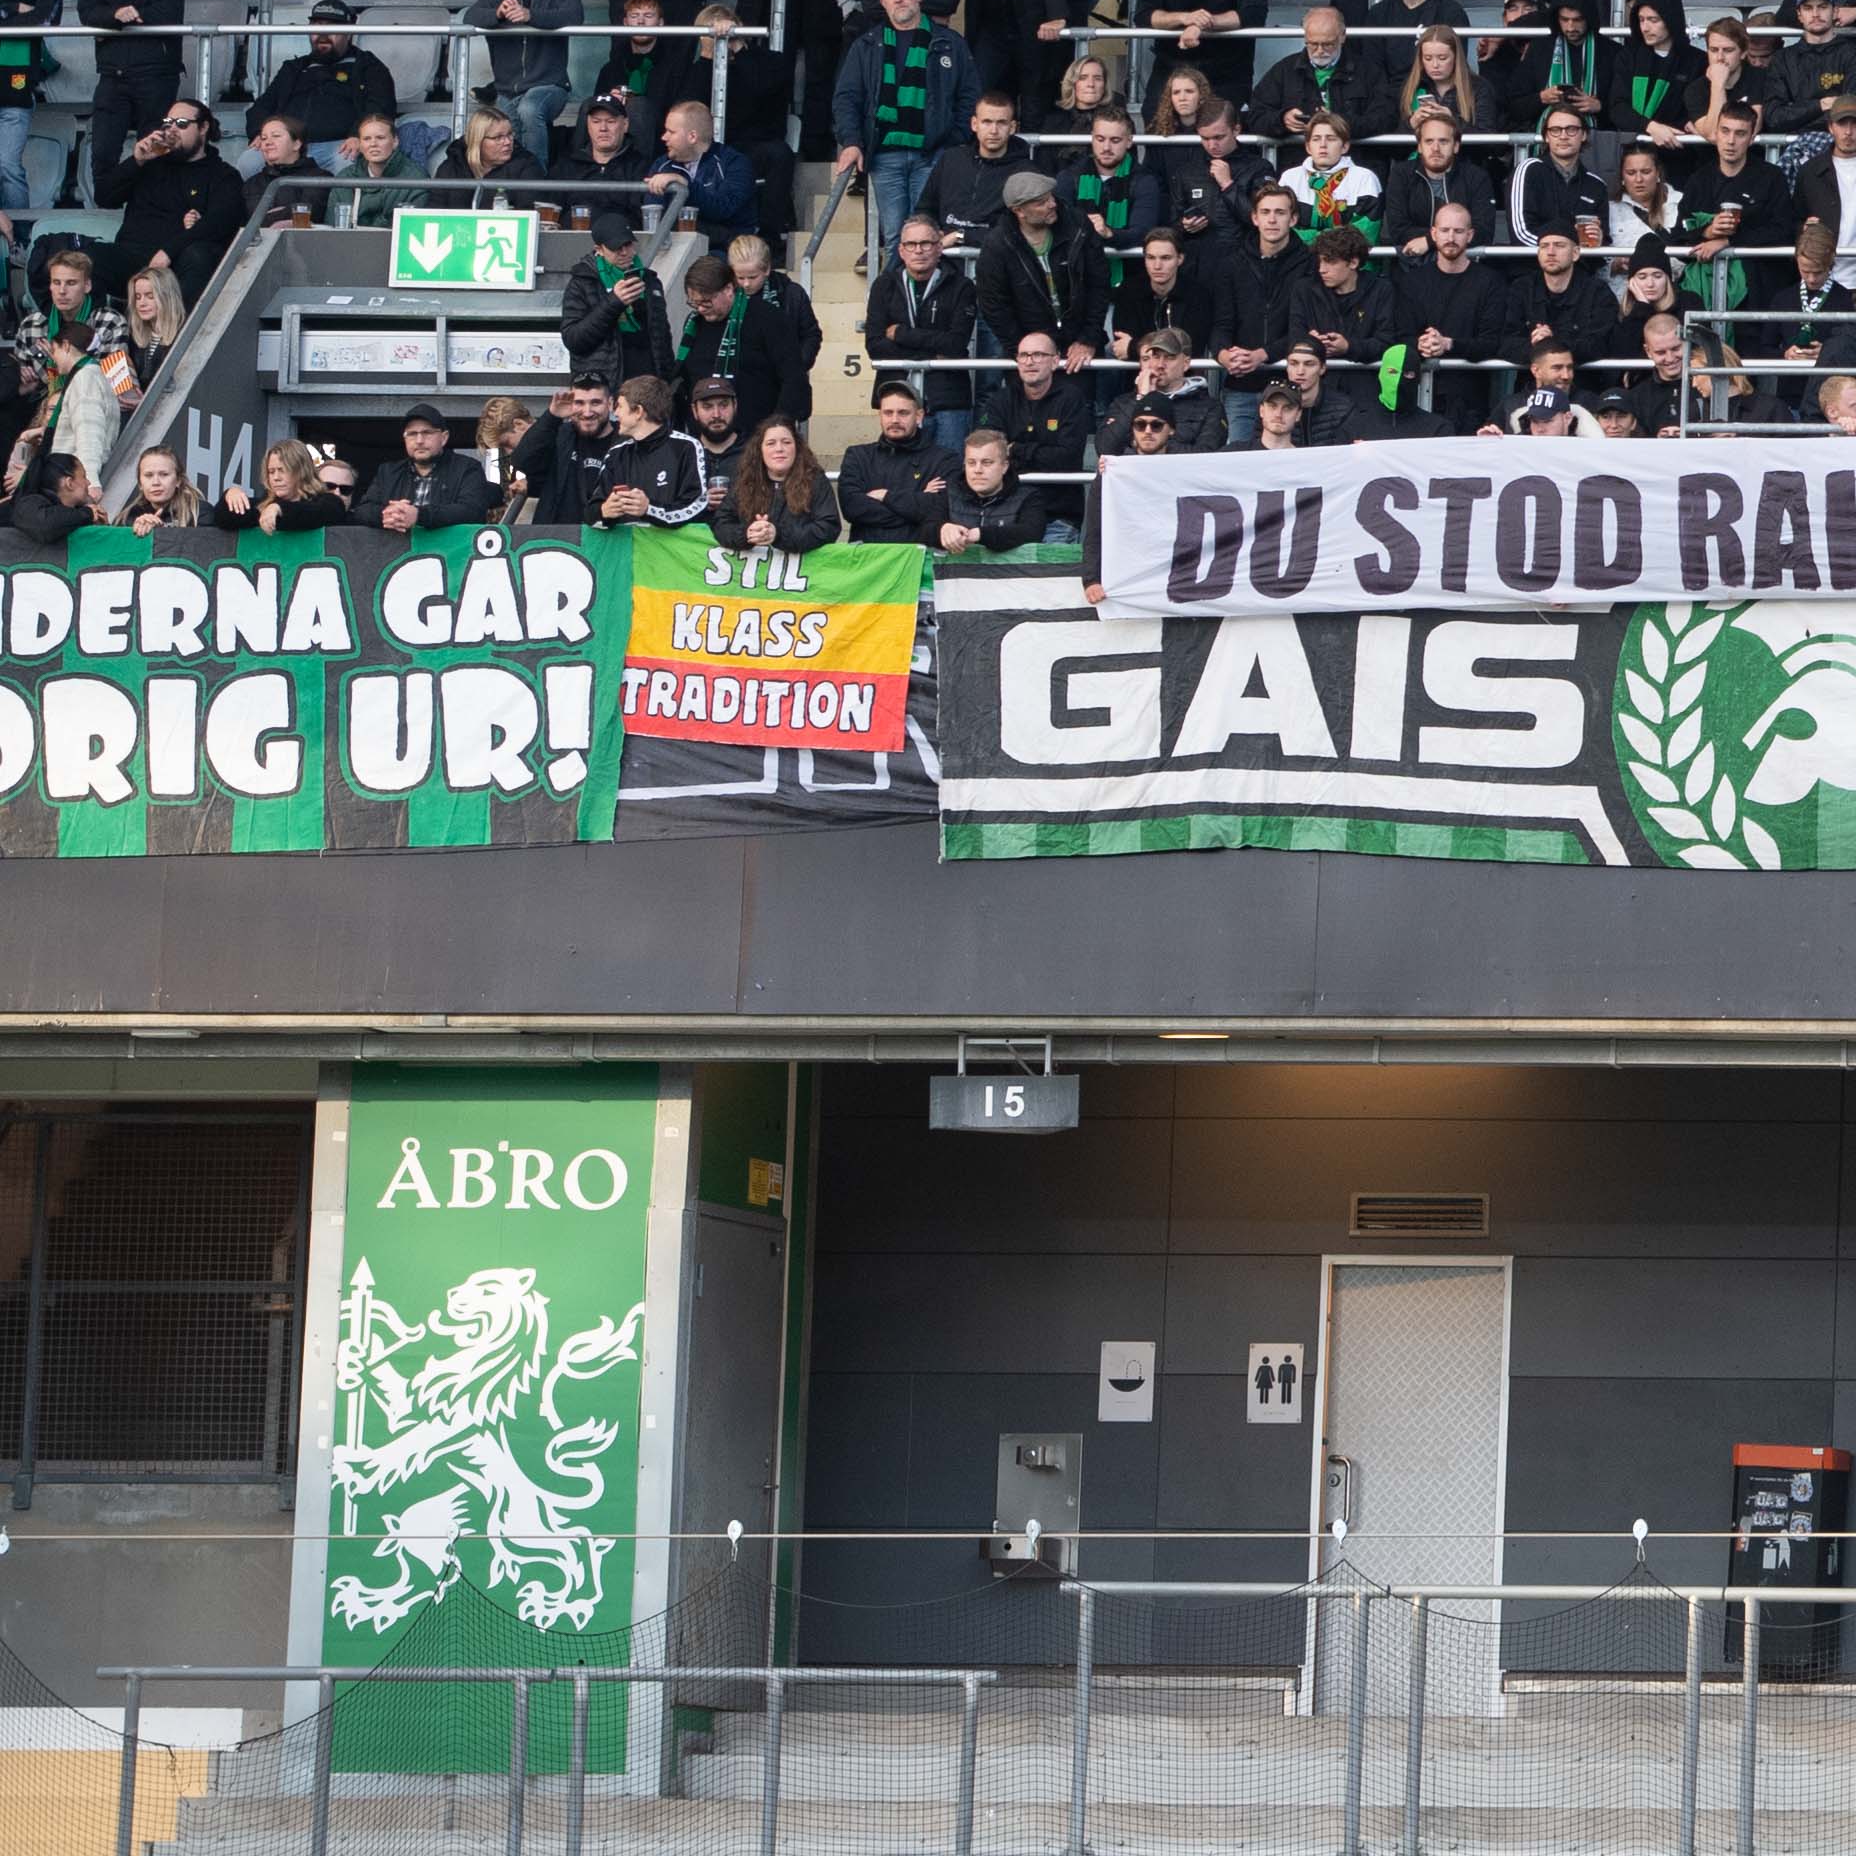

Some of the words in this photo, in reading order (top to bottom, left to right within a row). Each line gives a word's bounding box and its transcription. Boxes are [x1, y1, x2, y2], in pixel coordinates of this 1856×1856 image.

[844, 355, 861, 377] 5
[186, 407, 254, 507] H4
[705, 544, 808, 592] STIL
[1167, 487, 1322, 603] DU
[1355, 475, 1642, 595] STOD
[0, 563, 352, 656] DERNA
[383, 528, 592, 647] GÅR
[673, 603, 828, 658] KLASS
[351, 664, 592, 794] UR!
[622, 668, 874, 734] TRADITION
[1001, 615, 1585, 769] GAIS
[984, 1086, 1025, 1119] 15
[378, 1137, 629, 1211] ÅBRO
